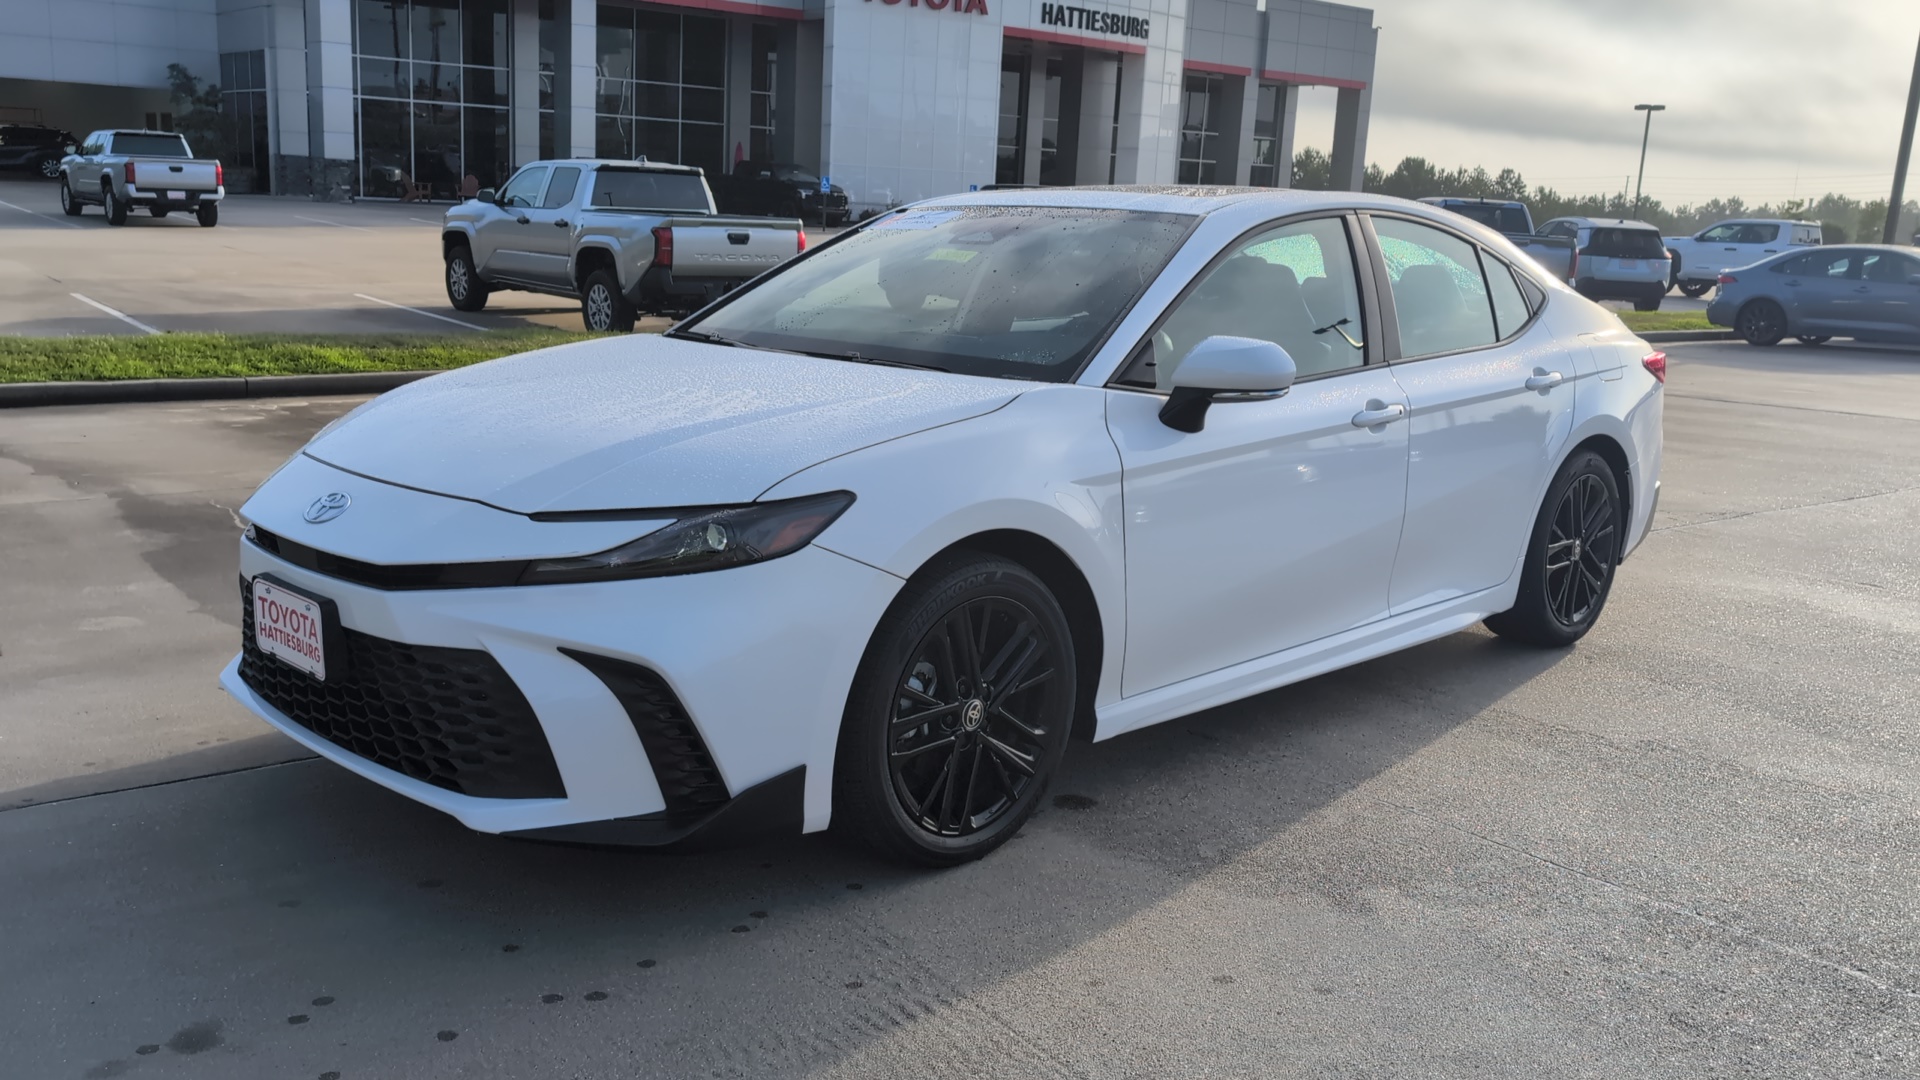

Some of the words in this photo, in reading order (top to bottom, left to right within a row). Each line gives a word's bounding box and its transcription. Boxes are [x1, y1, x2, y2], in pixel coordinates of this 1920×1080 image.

[1041, 2, 1149, 39] HATTIESBURG
[694, 253, 780, 262] TACOMA
[258, 596, 319, 644] TOYOTA
[260, 621, 321, 663] HATTIESBURG
